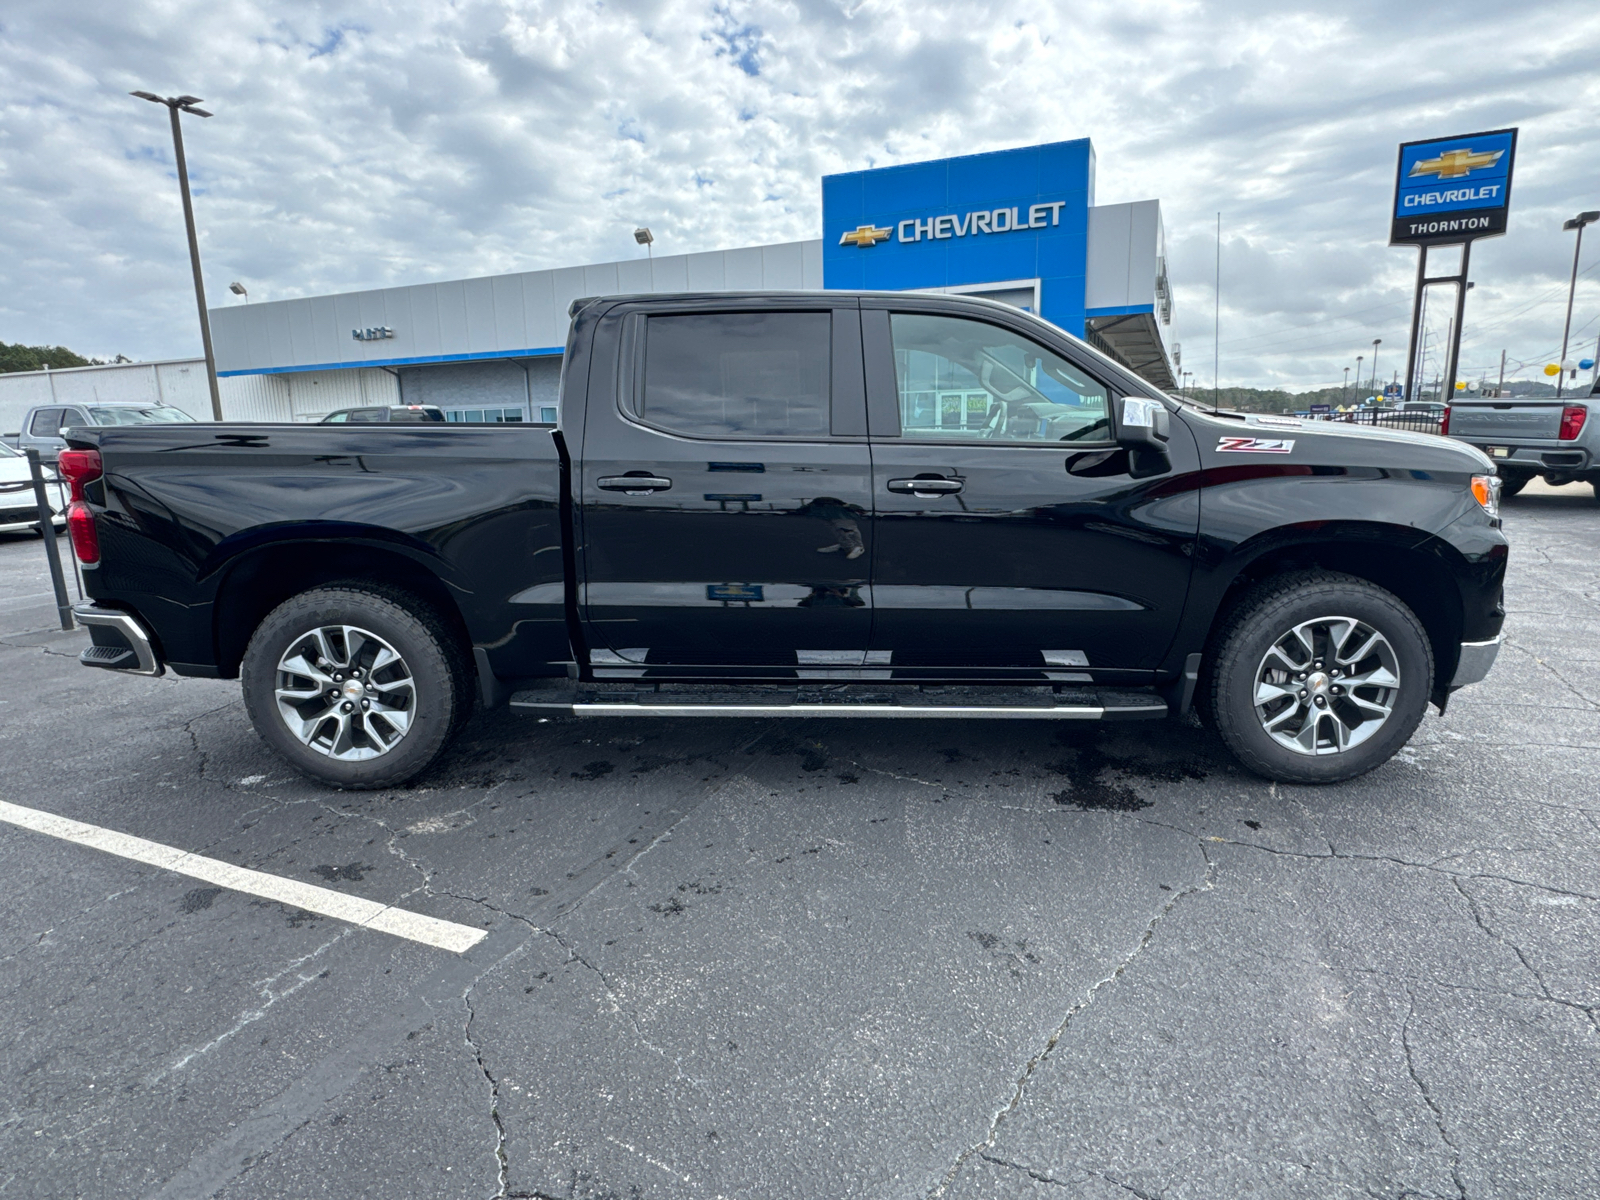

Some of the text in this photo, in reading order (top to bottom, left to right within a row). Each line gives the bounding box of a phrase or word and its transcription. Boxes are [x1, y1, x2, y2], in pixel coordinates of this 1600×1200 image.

[1404, 185, 1501, 207] CHEVROLET
[898, 201, 1066, 243] CHEVROLET
[1410, 217, 1490, 235] THORNTON
[1215, 436, 1296, 454] Z71
